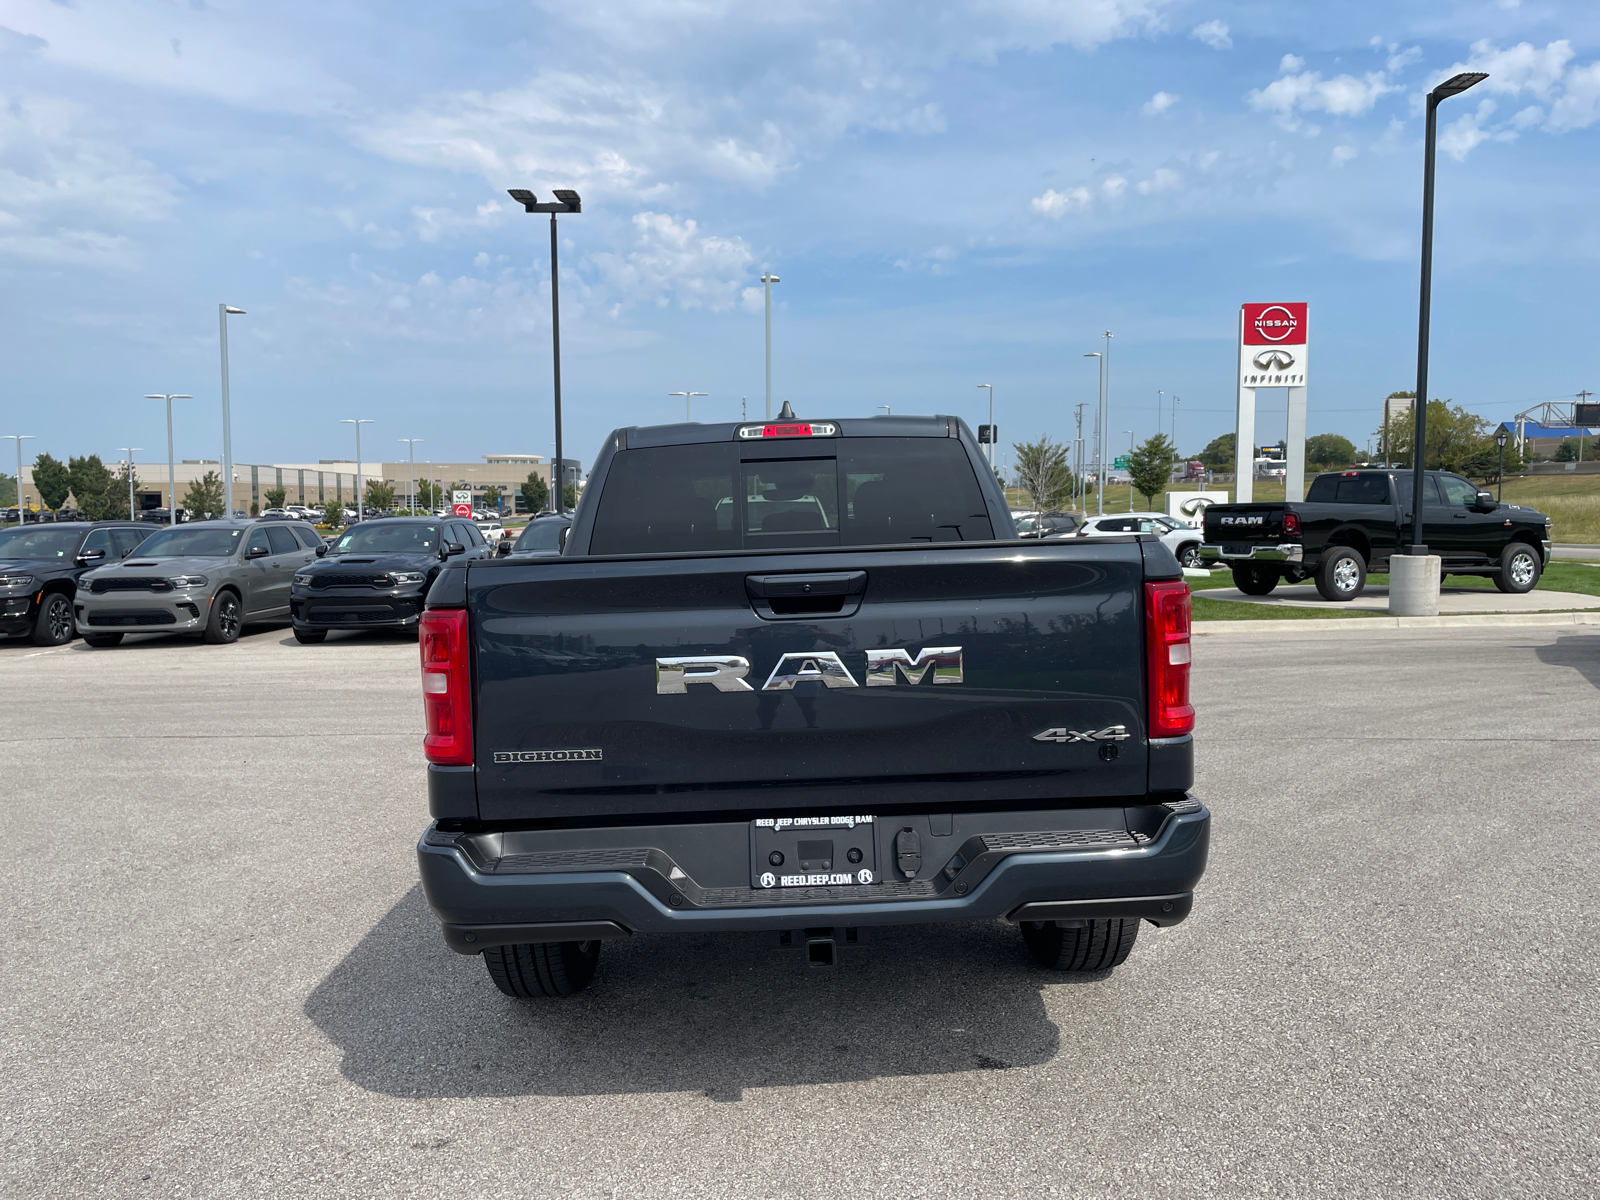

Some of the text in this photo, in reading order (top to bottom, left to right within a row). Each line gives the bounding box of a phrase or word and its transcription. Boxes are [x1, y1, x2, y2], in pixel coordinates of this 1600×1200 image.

[1243, 374, 1304, 384] INFINITI
[1220, 516, 1263, 525] RAM
[656, 646, 963, 695] RAM
[493, 749, 603, 764] BIGHORN
[756, 815, 873, 827] REED JEEP CHRYSLER DODGE RAM
[781, 874, 852, 886] REEDJEEP.COM
